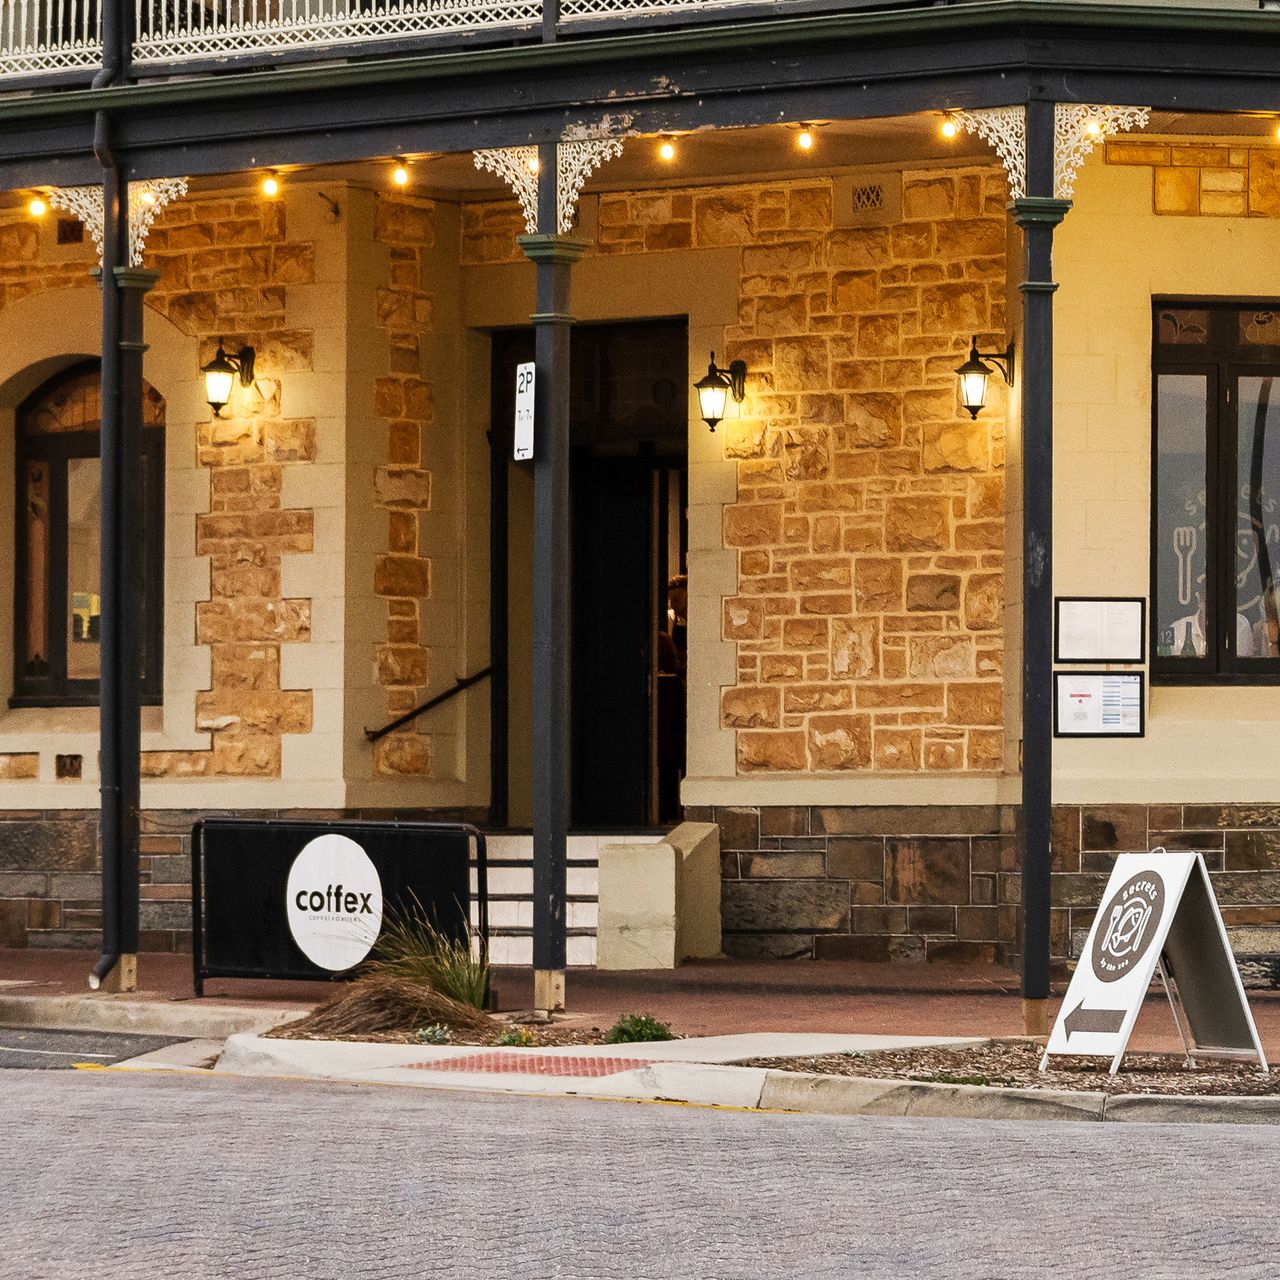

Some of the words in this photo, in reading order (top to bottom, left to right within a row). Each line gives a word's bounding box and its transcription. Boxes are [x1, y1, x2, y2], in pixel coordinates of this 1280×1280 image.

[518, 371, 533, 394] 2P
[295, 884, 373, 914] coffex
[1122, 881, 1158, 901] secrets
